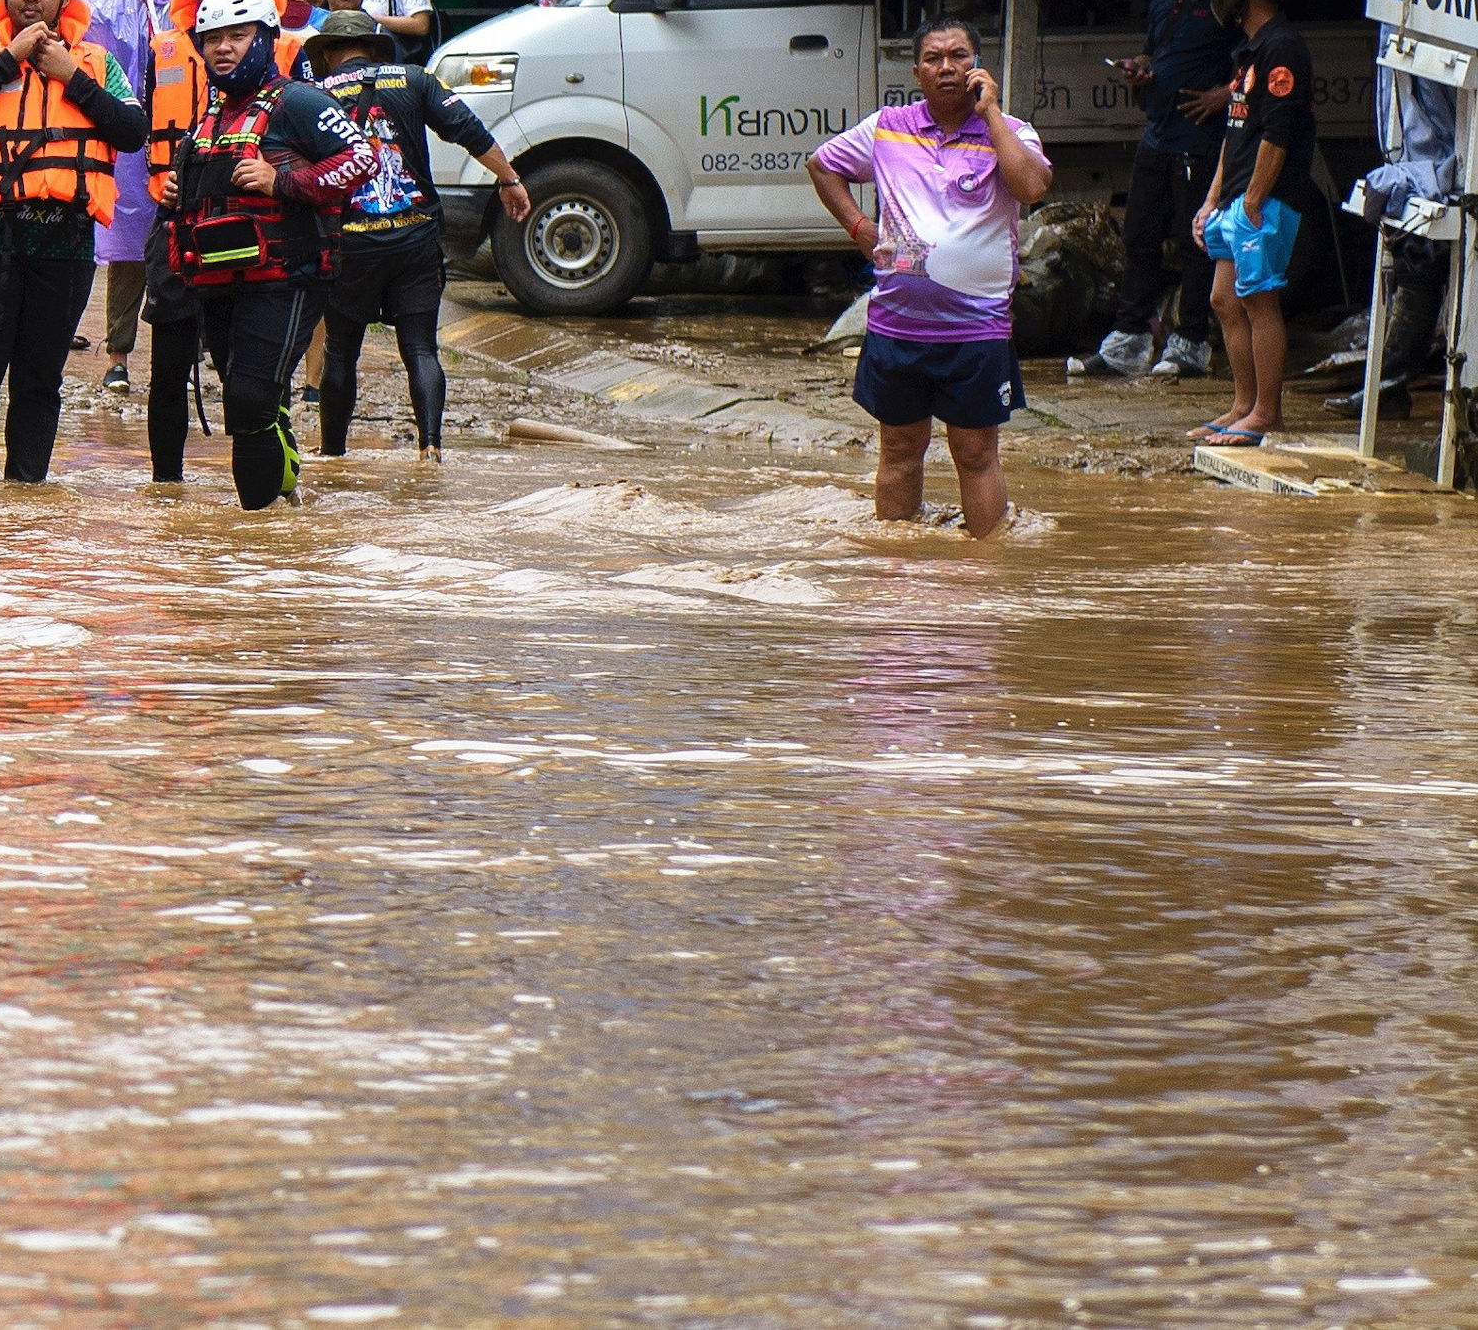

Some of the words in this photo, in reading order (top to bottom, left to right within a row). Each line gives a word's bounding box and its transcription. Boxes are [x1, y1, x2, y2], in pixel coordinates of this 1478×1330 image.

[700, 95, 847, 136] หยกงาม
[1196, 451, 1221, 474] INSTALL
